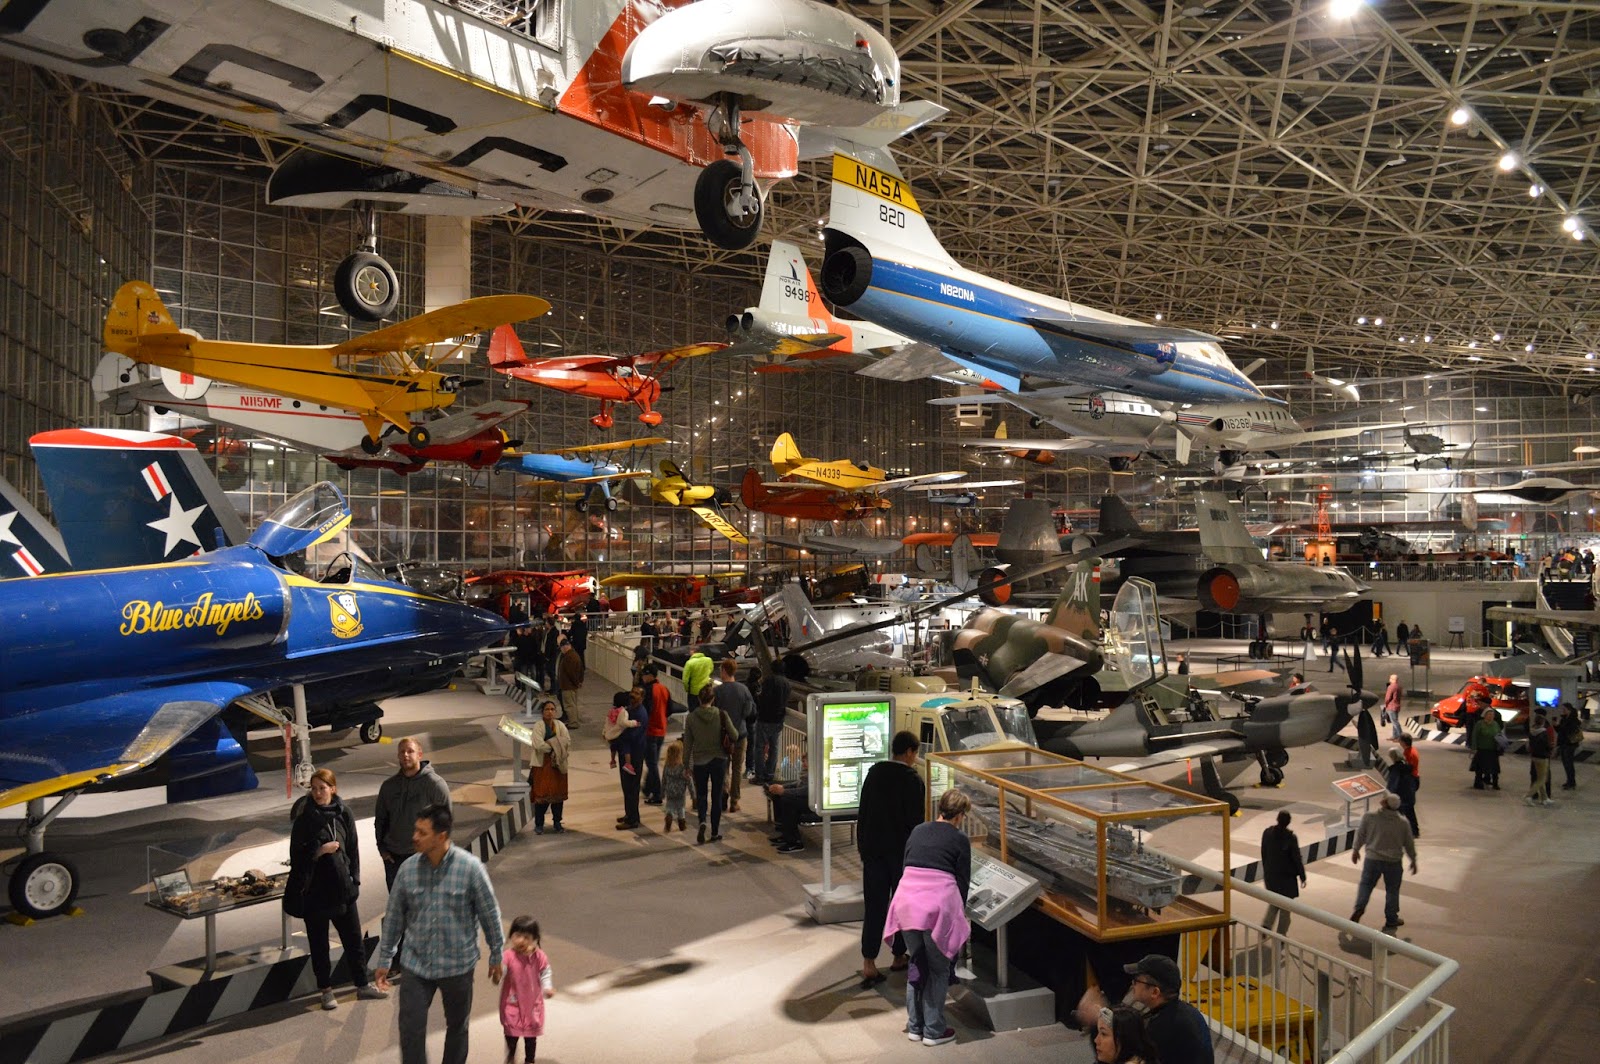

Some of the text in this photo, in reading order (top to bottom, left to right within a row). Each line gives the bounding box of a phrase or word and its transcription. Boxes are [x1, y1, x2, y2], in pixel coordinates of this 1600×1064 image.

[856, 164, 902, 202] NASA
[879, 204, 905, 229] 820
[780, 277, 802, 287] NORAIR
[940, 282, 975, 303] N820NA
[785, 285, 816, 304] 94987
[240, 395, 282, 409] N115MF
[816, 467, 840, 479] N4339
[702, 512, 743, 540] NR77V
[1073, 571, 1088, 602] AK
[120, 592, 264, 637] Blue Angels
